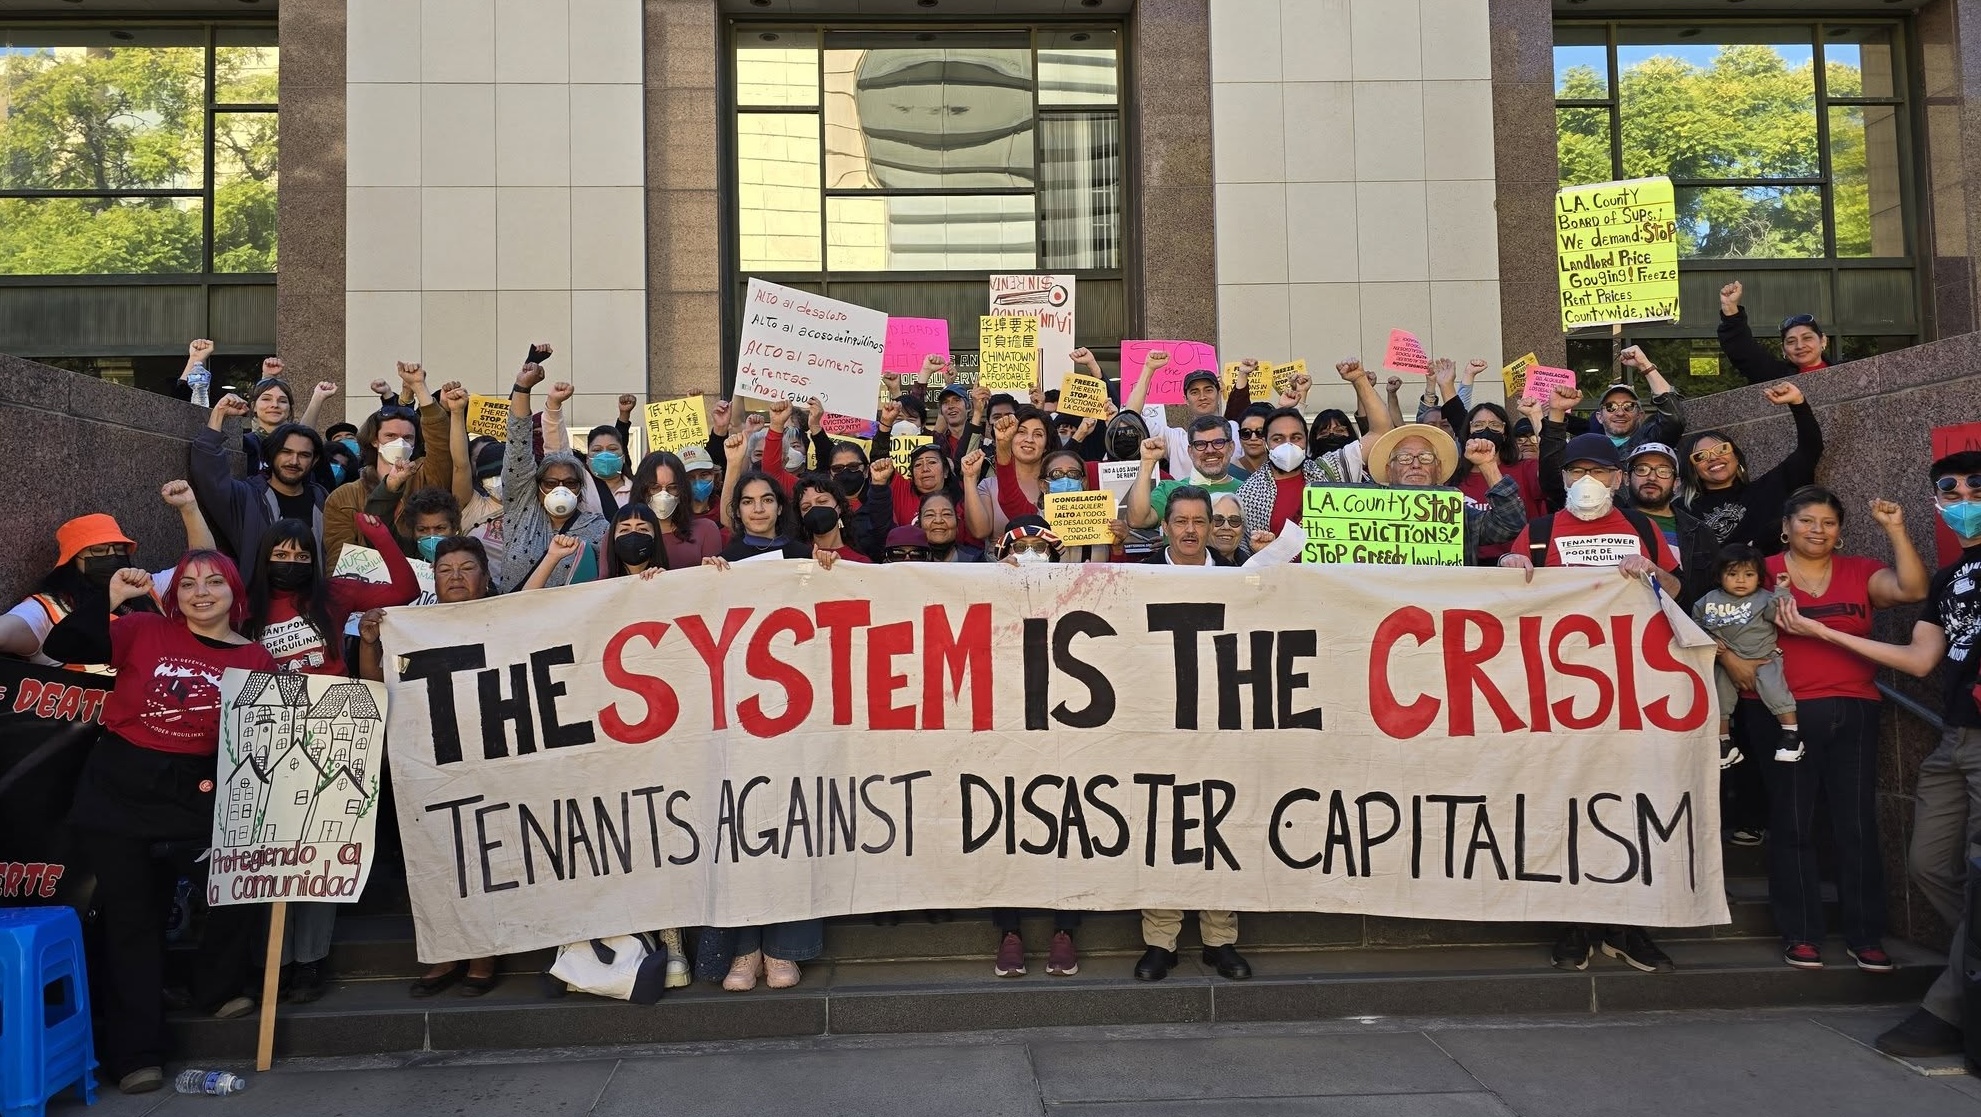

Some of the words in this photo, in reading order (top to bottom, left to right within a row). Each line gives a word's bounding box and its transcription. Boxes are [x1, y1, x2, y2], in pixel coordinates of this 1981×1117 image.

[1604, 211, 1617, 224] of
[1637, 266, 1677, 282] Freeze
[782, 299, 795, 309] al
[782, 324, 794, 333] al
[798, 326, 835, 341] acoso
[786, 350, 803, 361] al
[981, 351, 1036, 363] CHINATOWN
[741, 362, 757, 376] de
[986, 362, 1031, 373] DEMANDS
[1164, 367, 1181, 376] the
[900, 373, 919, 386] OF
[980, 372, 1031, 381] AFFORDABLE
[985, 381, 1027, 389] HOUSING
[1073, 378, 1099, 388] FREEZE
[1070, 391, 1088, 399] STOP
[483, 401, 511, 410] FREEZ
[1063, 396, 1097, 408] EVICTIONS
[480, 407, 493, 416] THE
[492, 409, 509, 417] REN
[647, 400, 695, 417] 低收入
[472, 420, 507, 431] EVICTION
[822, 418, 854, 426] EVICTIONS
[473, 426, 484, 434] LA
[484, 428, 507, 438] COUN
[1069, 502, 1104, 510] ALQUILER!
[1304, 520, 1336, 539] the
[1062, 533, 1101, 541] CONDADO!
[1561, 538, 1599, 547] TENANT
[1601, 537, 1635, 545] POWER
[1565, 548, 1597, 556] PODER
[287, 633, 300, 641] DE
[398, 642, 595, 766] THE
[598, 599, 993, 745] SYSTEM
[1022, 610, 1117, 731] IS
[1146, 603, 1323, 731] THE
[1368, 605, 1709, 740] CRISIS
[150, 725, 170, 735] PODER
[425, 784, 700, 898] TENANTS
[714, 769, 933, 864] AGAINST
[960, 772, 1242, 871] DISASTER
[1268, 786, 1697, 892] CAPITALISM
[211, 839, 317, 875] Protegiendo
[337, 842, 363, 866] a
[207, 879, 220, 906] la
[231, 860, 362, 900] comunidad
